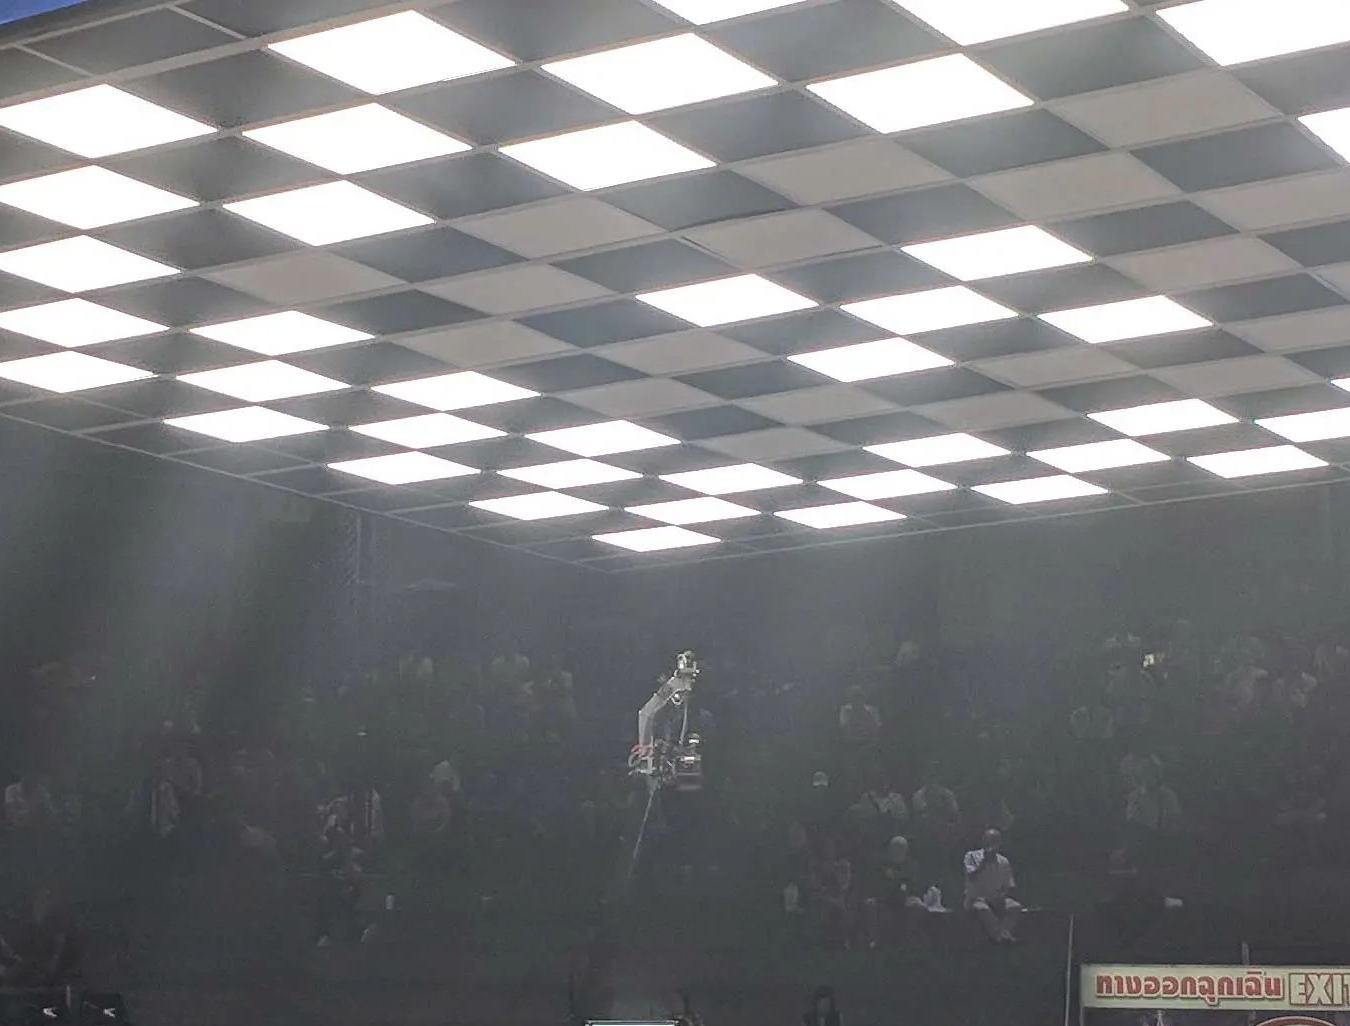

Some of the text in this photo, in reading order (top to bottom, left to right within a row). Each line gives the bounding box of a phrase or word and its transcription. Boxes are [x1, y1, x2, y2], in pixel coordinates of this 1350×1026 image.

[1095, 970, 1285, 1007] ทางออกฉุกเฉิน
